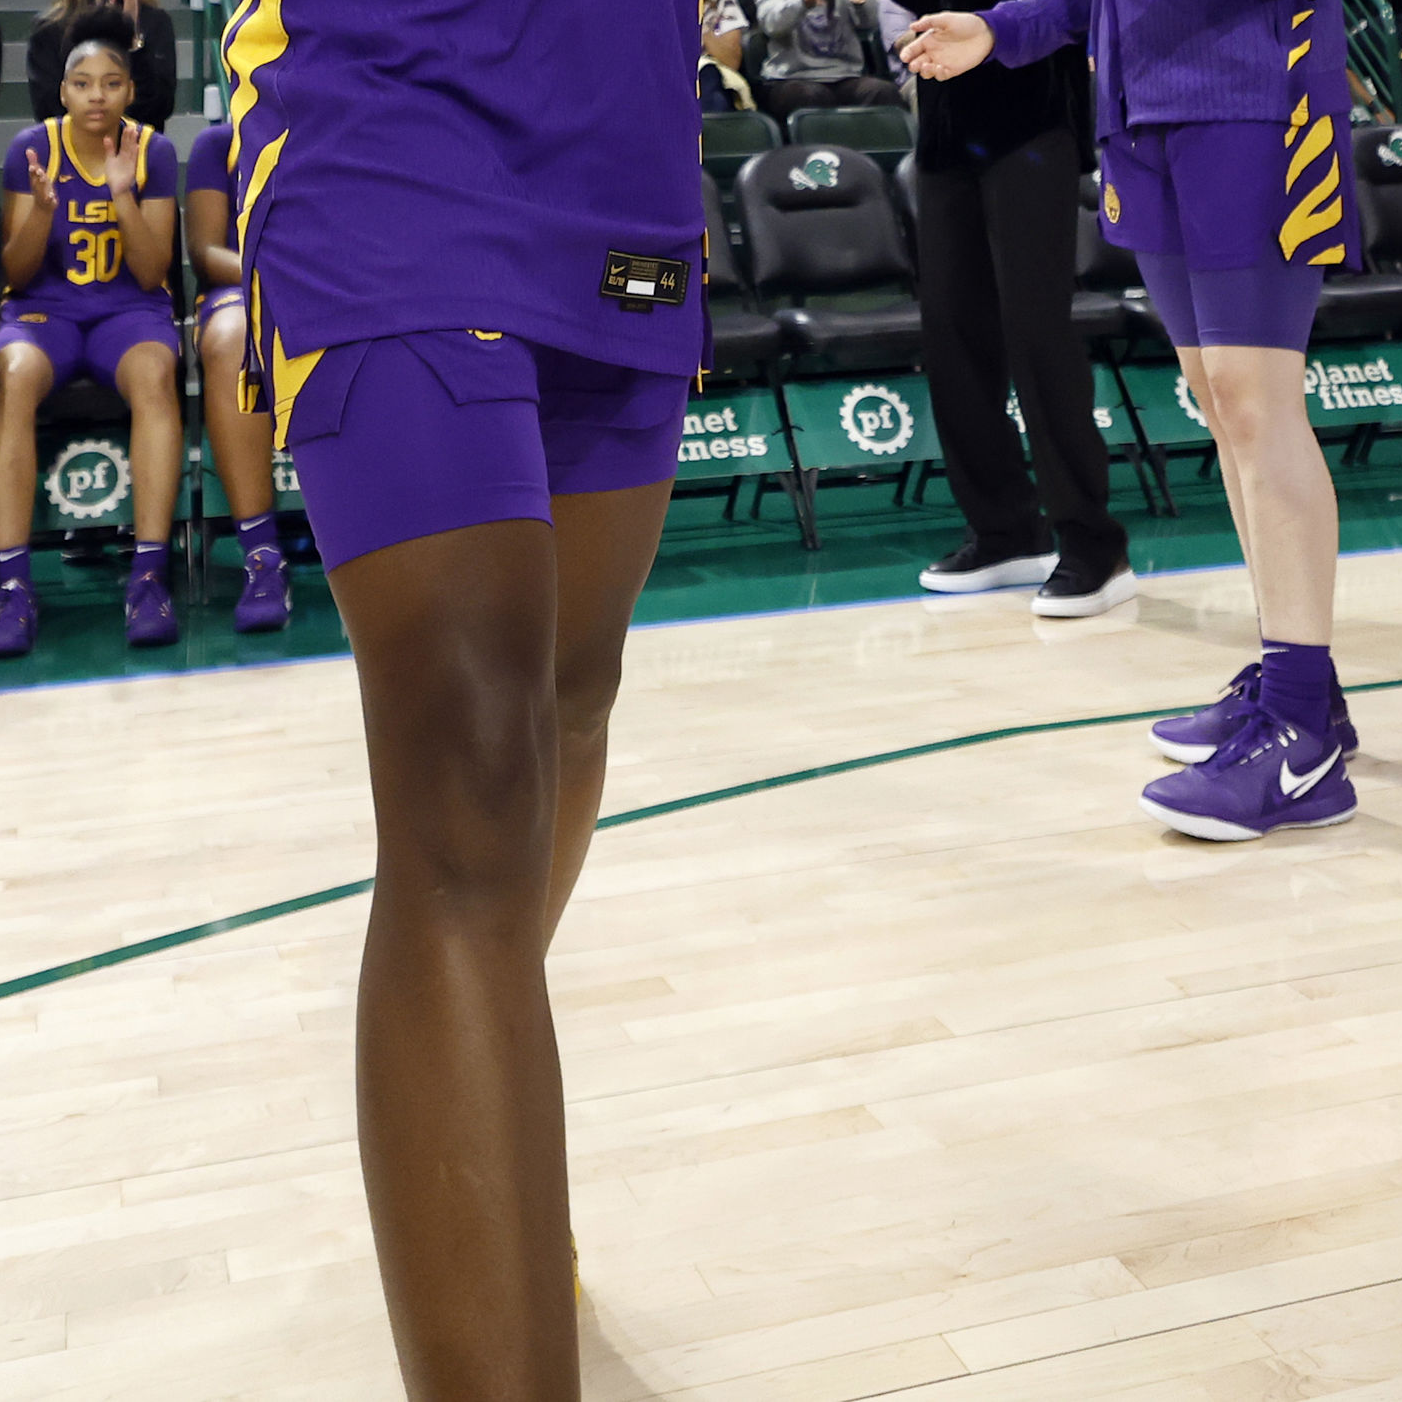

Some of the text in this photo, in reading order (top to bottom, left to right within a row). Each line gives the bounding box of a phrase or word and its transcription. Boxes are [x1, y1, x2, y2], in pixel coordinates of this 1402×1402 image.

[67, 228, 123, 286] 30
[660, 271, 677, 291] 44
[1304, 358, 1394, 394] planet
[683, 407, 739, 435] net
[857, 404, 895, 437] pf
[67, 463, 110, 498] pf
